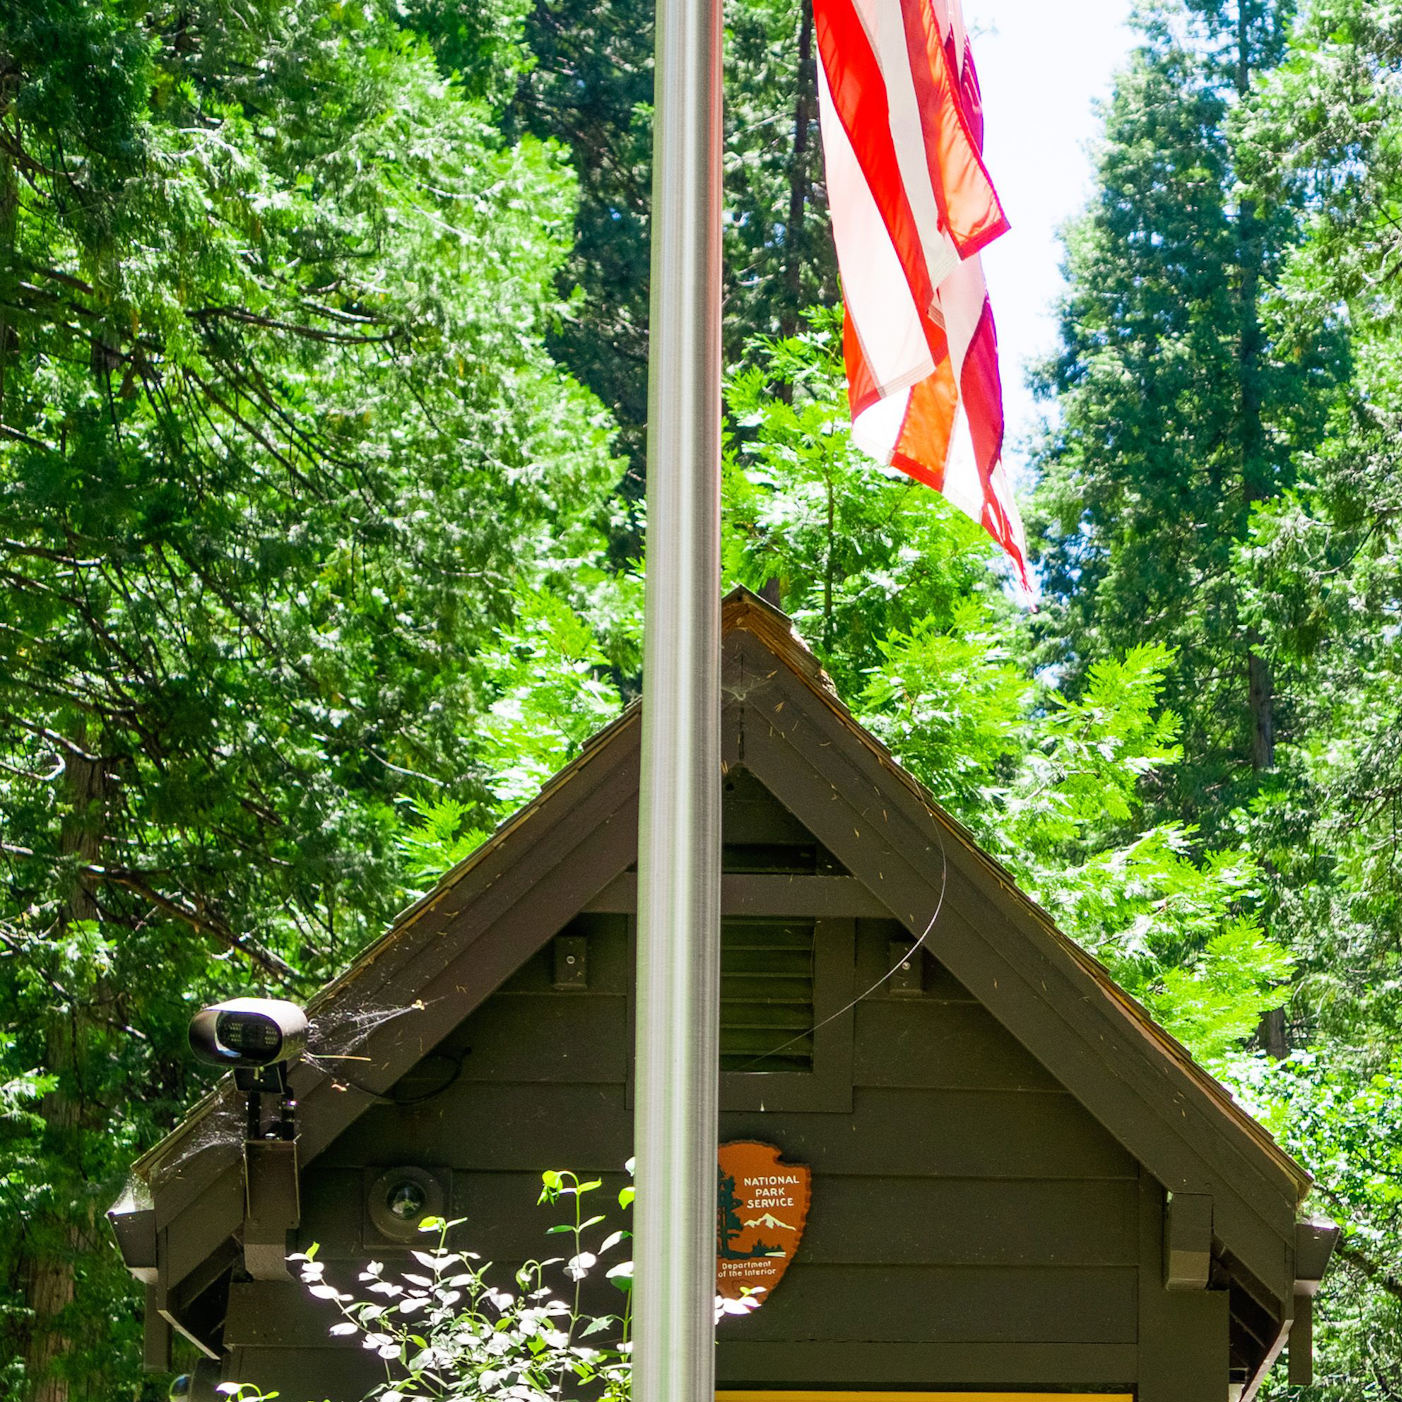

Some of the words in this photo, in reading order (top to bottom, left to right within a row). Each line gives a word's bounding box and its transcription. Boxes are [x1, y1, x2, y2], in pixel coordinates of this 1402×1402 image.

[743, 1175, 800, 1187] NATIONAL
[755, 1187, 785, 1198] PARK
[746, 1197, 795, 1209] SERVICE
[722, 1261, 771, 1270] Department
